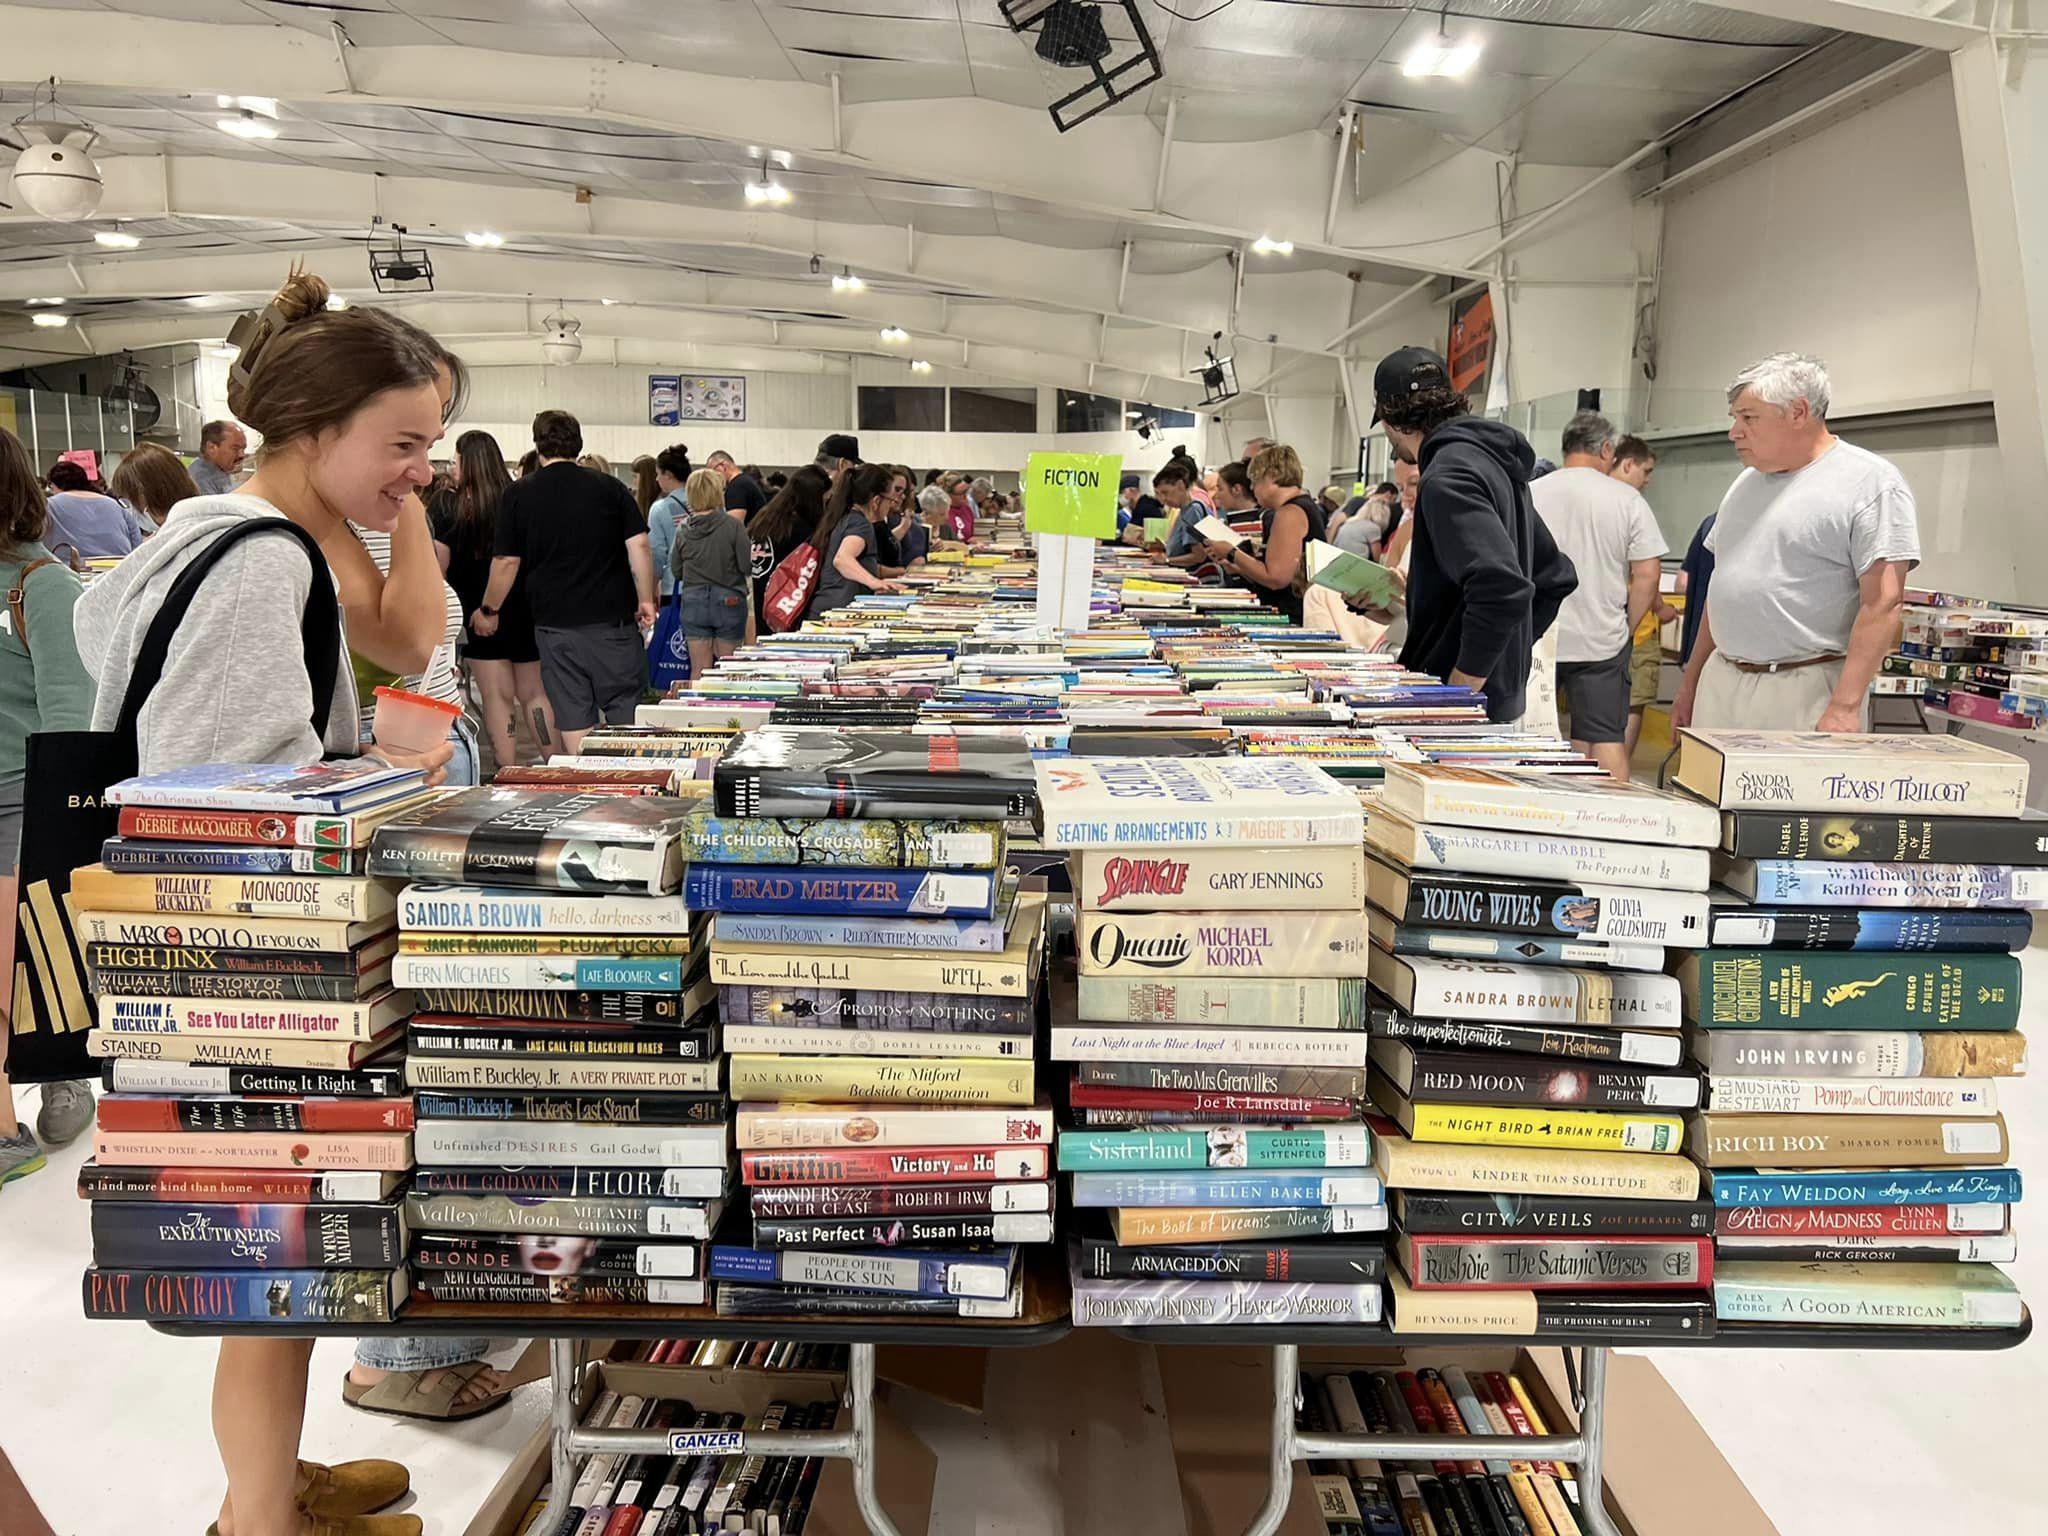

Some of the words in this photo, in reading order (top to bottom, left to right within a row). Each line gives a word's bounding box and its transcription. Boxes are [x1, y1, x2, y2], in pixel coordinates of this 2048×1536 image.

[1044, 469, 1099, 488] FICTION
[776, 558, 817, 615] Roots
[1742, 785, 1794, 801] BROWN
[1822, 773, 1884, 802] TEXAS!
[1890, 775, 1970, 802] TRILOGY
[68, 794, 112, 808] BAR
[135, 791, 152, 802] The
[155, 792, 203, 805] Christmas
[206, 796, 233, 805] Shoes
[135, 816, 179, 834] DEBBIE
[181, 818, 254, 838] MACOMBER
[1057, 823, 1107, 842] SEATING
[1115, 822, 1207, 841] ARRANGEMENTS
[1239, 821, 1286, 839] MAGGIE
[692, 835, 719, 846] THE
[725, 835, 808, 848] CHILDREN'S
[815, 837, 881, 849] CRUSADE
[1776, 822, 1791, 856] ISABEL
[1795, 816, 1809, 860] ALLENDE
[111, 851, 160, 863] DEBBIE
[164, 854, 241, 865] MACOMBER
[382, 849, 407, 860] KEN
[410, 850, 462, 863] FOLLETT
[468, 854, 534, 867] JACKDAWS
[155, 878, 201, 894] WILLIAM
[1097, 856, 1190, 907] SPANGLE
[1209, 873, 1247, 890] GARY
[1251, 872, 1323, 889] JENNINGS
[241, 881, 320, 903] MONGOOSE
[731, 879, 793, 900] BRAD
[801, 880, 900, 902] MELTZER
[405, 902, 472, 927] SANDRA
[479, 903, 541, 927] BROWN
[549, 906, 586, 925] hello,
[590, 907, 652, 925] darkness
[1422, 888, 1484, 922] YOUNG
[1489, 892, 1541, 927] WIVES
[1609, 897, 1642, 918] OLIVIA
[1197, 927, 1272, 946] MICHAEL
[1607, 919, 1666, 940] GOLDSMITH
[190, 928, 252, 948] POLO
[257, 935, 269, 946] IF
[271, 936, 292, 948] YOU
[296, 937, 320, 949] CAN
[424, 938, 465, 952] JANET
[468, 939, 538, 953] EVANOVICH
[560, 939, 609, 953] PLUM
[615, 939, 672, 953] LUCKY
[1091, 923, 1192, 968] Queenie
[95, 946, 160, 967] HIGH
[163, 949, 217, 969] JINX
[1207, 947, 1263, 967] KORDA
[408, 963, 441, 982] FERN
[445, 965, 510, 984] MICHAELS
[583, 969, 603, 982] LATE
[606, 969, 656, 984] BLOOMER
[189, 976, 212, 987] THE
[217, 977, 260, 989] STORY
[266, 978, 282, 990] OF
[1444, 991, 1508, 1006] SANDRA
[1517, 994, 1573, 1009] BROWN
[1906, 975, 1917, 1011] CONGO
[1923, 972, 1933, 1013] SPHERE
[116, 1002, 162, 1017] WILLIAM
[496, 991, 567, 1018] BROWN
[1588, 998, 1647, 1012] LETHAL
[921, 1007, 996, 1021] NOTHING
[187, 1011, 212, 1029] See
[215, 1012, 238, 1029] You
[241, 1013, 276, 1031] Later
[279, 1014, 339, 1034] Alligator
[101, 1039, 162, 1055] STAINED
[1100, 1036, 1130, 1050] Night
[1164, 1038, 1188, 1050] Blue
[1192, 1038, 1225, 1051] Angel
[195, 1045, 261, 1060] WILLIAM
[1736, 1048, 1785, 1065] JOHN
[1796, 1050, 1866, 1065] IRVING
[417, 1065, 471, 1085] William
[580, 1072, 608, 1084] VERY
[611, 1073, 655, 1085] PRIVATE
[659, 1073, 687, 1085] PLOT
[743, 1073, 767, 1082] JAN
[776, 1074, 823, 1083] KARON
[877, 1067, 904, 1081] The
[1423, 1072, 1463, 1089] RED
[1469, 1075, 1526, 1092] MOON
[241, 1075, 297, 1092] Getting
[301, 1076, 313, 1090] It
[317, 1076, 356, 1094] Right
[1195, 1095, 1219, 1109] Joe
[1226, 1096, 1242, 1110] R.
[1246, 1096, 1311, 1112] Lansdale
[1448, 1119, 1493, 1133] NIGHT
[1500, 1122, 1533, 1135] BIRD
[1557, 1125, 1593, 1137] BRIAN
[433, 1140, 501, 1152] Unfinished
[590, 1143, 616, 1154] Gail
[1088, 1138, 1192, 1160] Sisterland
[1271, 1139, 1310, 1148] CURTIS
[1716, 1137, 1776, 1152] RICH
[1783, 1136, 1830, 1152] BOY
[1260, 1150, 1326, 1160] SITTENFELD
[891, 1156, 950, 1174] Victory
[98, 1181, 123, 1191] land
[127, 1183, 156, 1192] more
[160, 1181, 187, 1192] kind
[191, 1181, 217, 1192] than
[221, 1181, 252, 1193] home
[1472, 1169, 1528, 1182] KINDER
[1535, 1173, 1567, 1184] THAN
[1572, 1175, 1647, 1189] SOLITUDE
[264, 1184, 310, 1195] WILEY
[761, 1188, 839, 1203] WONDERS
[1210, 1187, 1262, 1199] ELLEN
[1738, 1186, 1773, 1201] FAY
[1781, 1185, 1866, 1201] WELDON
[895, 1192, 949, 1206] ROBERT
[762, 1203, 815, 1216] NEVER
[823, 1202, 872, 1215] CEASE
[1727, 1205, 1794, 1229] REIGN
[1899, 1206, 1934, 1218] LYNN
[1461, 1212, 1508, 1226] CITY
[1533, 1213, 1593, 1226] VEILS
[1808, 1212, 1882, 1229] MADNESS
[1892, 1218, 1942, 1230] CULLEN
[321, 1213, 336, 1263] NORMAN
[336, 1214, 352, 1263] MAILER
[777, 1229, 809, 1243] Past
[813, 1227, 865, 1242] Perfect
[913, 1224, 956, 1240] Susan
[232, 1243, 267, 1261] Song
[420, 1251, 510, 1267] BLONDE
[1815, 1250, 1840, 1259] RICK
[1847, 1251, 1896, 1260] GEKOSKI
[808, 1256, 849, 1267] PEOPLE
[852, 1258, 868, 1269] OF
[872, 1260, 892, 1271] THE
[1132, 1257, 1241, 1272] ARMAGEDDON
[1538, 1250, 1596, 1280] Satanic
[1596, 1251, 1647, 1275] Verses
[805, 1268, 858, 1284] BLACK
[862, 1270, 895, 1286] SUN
[90, 1273, 130, 1313] PAT
[144, 1275, 237, 1315] CONROY
[1081, 1297, 1155, 1321] JOHANNA
[1728, 1303, 1773, 1313] GEORGE
[1800, 1300, 1850, 1315] GOOD
[1856, 1300, 1946, 1318] AMERICAN
[1415, 1315, 1479, 1326] REYNOLDS
[1484, 1316, 1518, 1326] PRICE
[675, 1433, 740, 1448] GANZER
